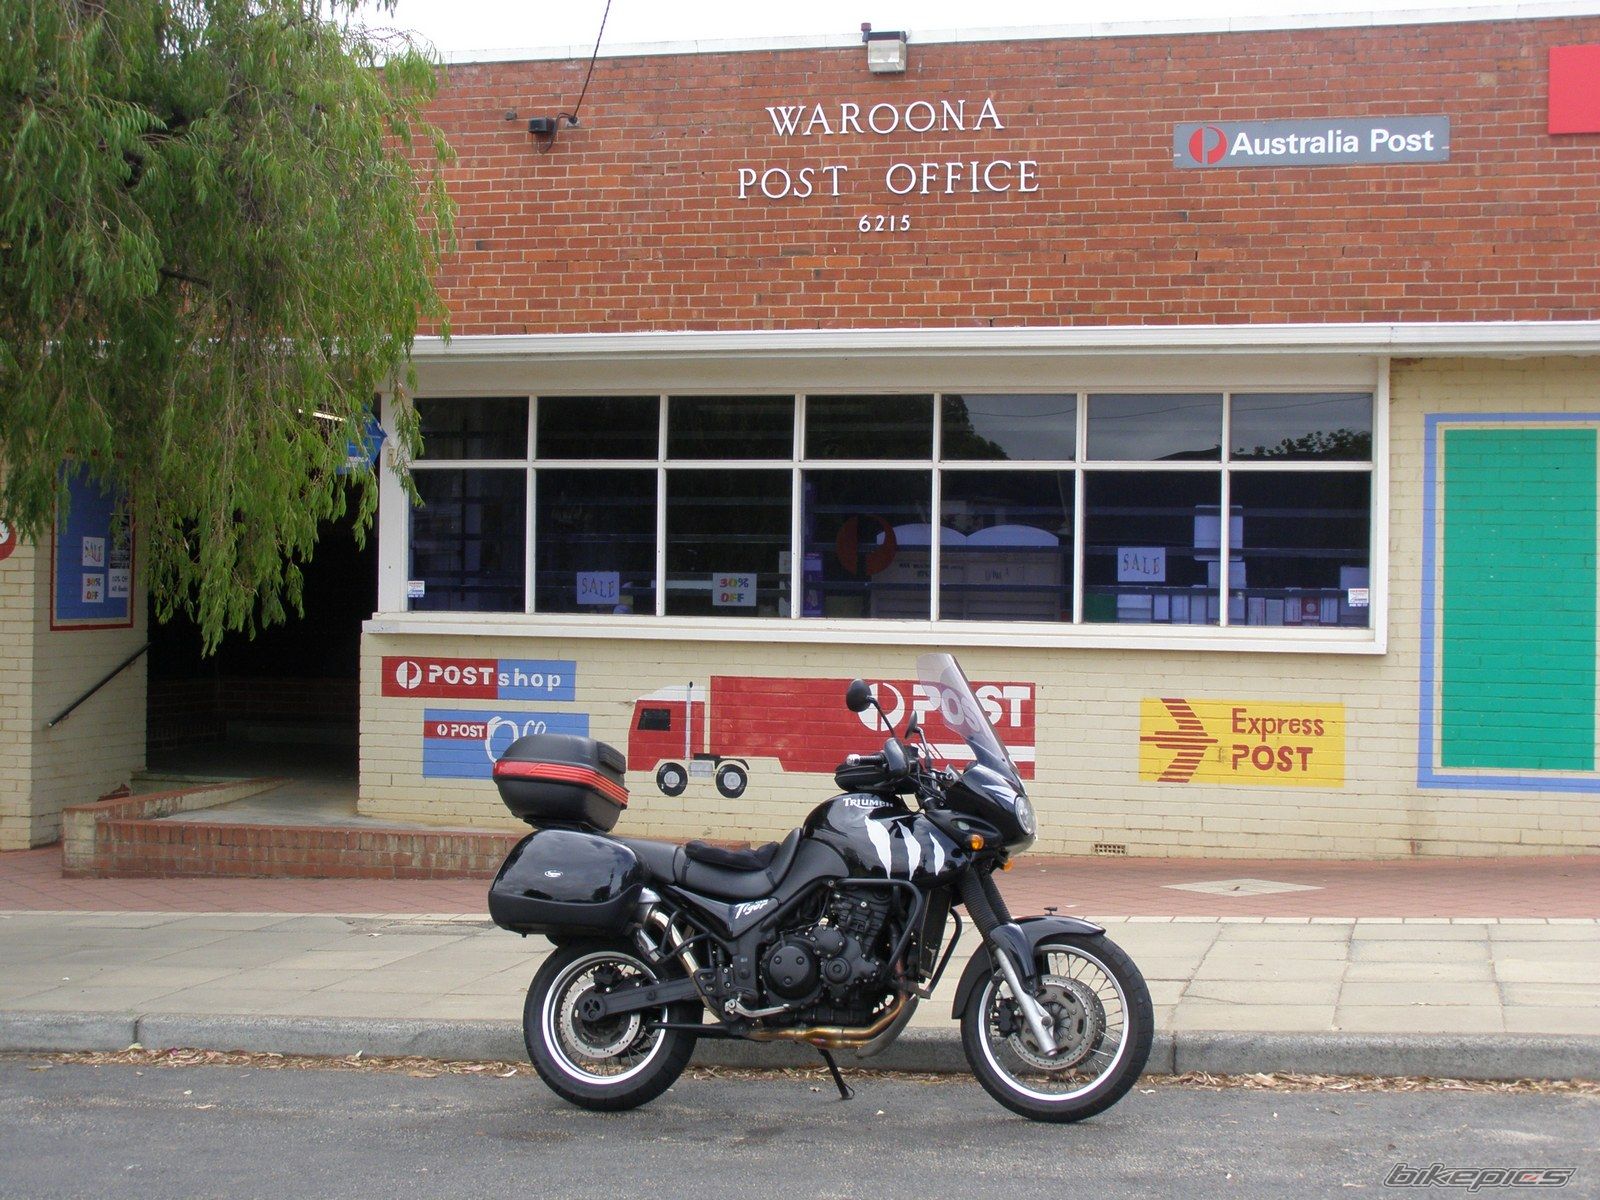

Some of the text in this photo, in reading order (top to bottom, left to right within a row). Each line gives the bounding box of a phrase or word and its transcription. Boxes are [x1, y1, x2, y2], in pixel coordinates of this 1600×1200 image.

[765, 97, 1005, 137] WAROONA
[1230, 128, 1434, 156] Australia Post
[738, 160, 1039, 199] POST OFFICE
[858, 214, 911, 233] 6215
[1123, 552, 1160, 575] SALE
[581, 576, 615, 599] SALE
[719, 578, 749, 588] 30%
[720, 592, 745, 603] OFF
[912, 683, 1031, 732] POST
[450, 724, 485, 738] POST
[1231, 707, 1325, 742] Express
[1231, 744, 1314, 773] POST
